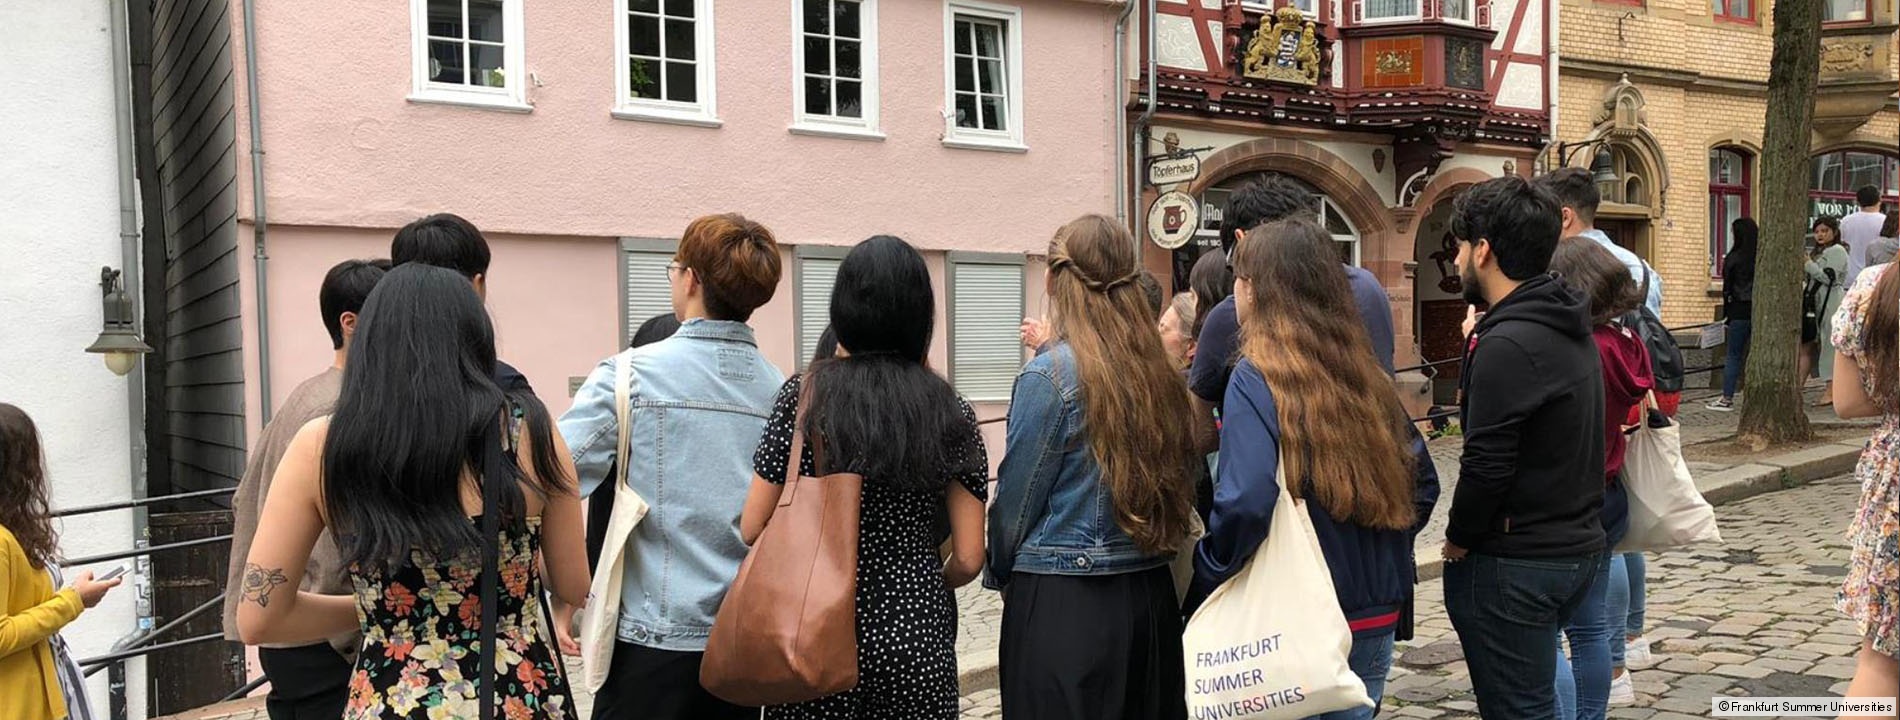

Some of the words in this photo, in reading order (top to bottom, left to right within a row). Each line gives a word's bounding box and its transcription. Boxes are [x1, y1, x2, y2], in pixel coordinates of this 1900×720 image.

[1196, 633, 1282, 668] FRANKFURT
[1194, 668, 1264, 694] SUMMER
[1195, 687, 1305, 720] UNIVERSITIES
